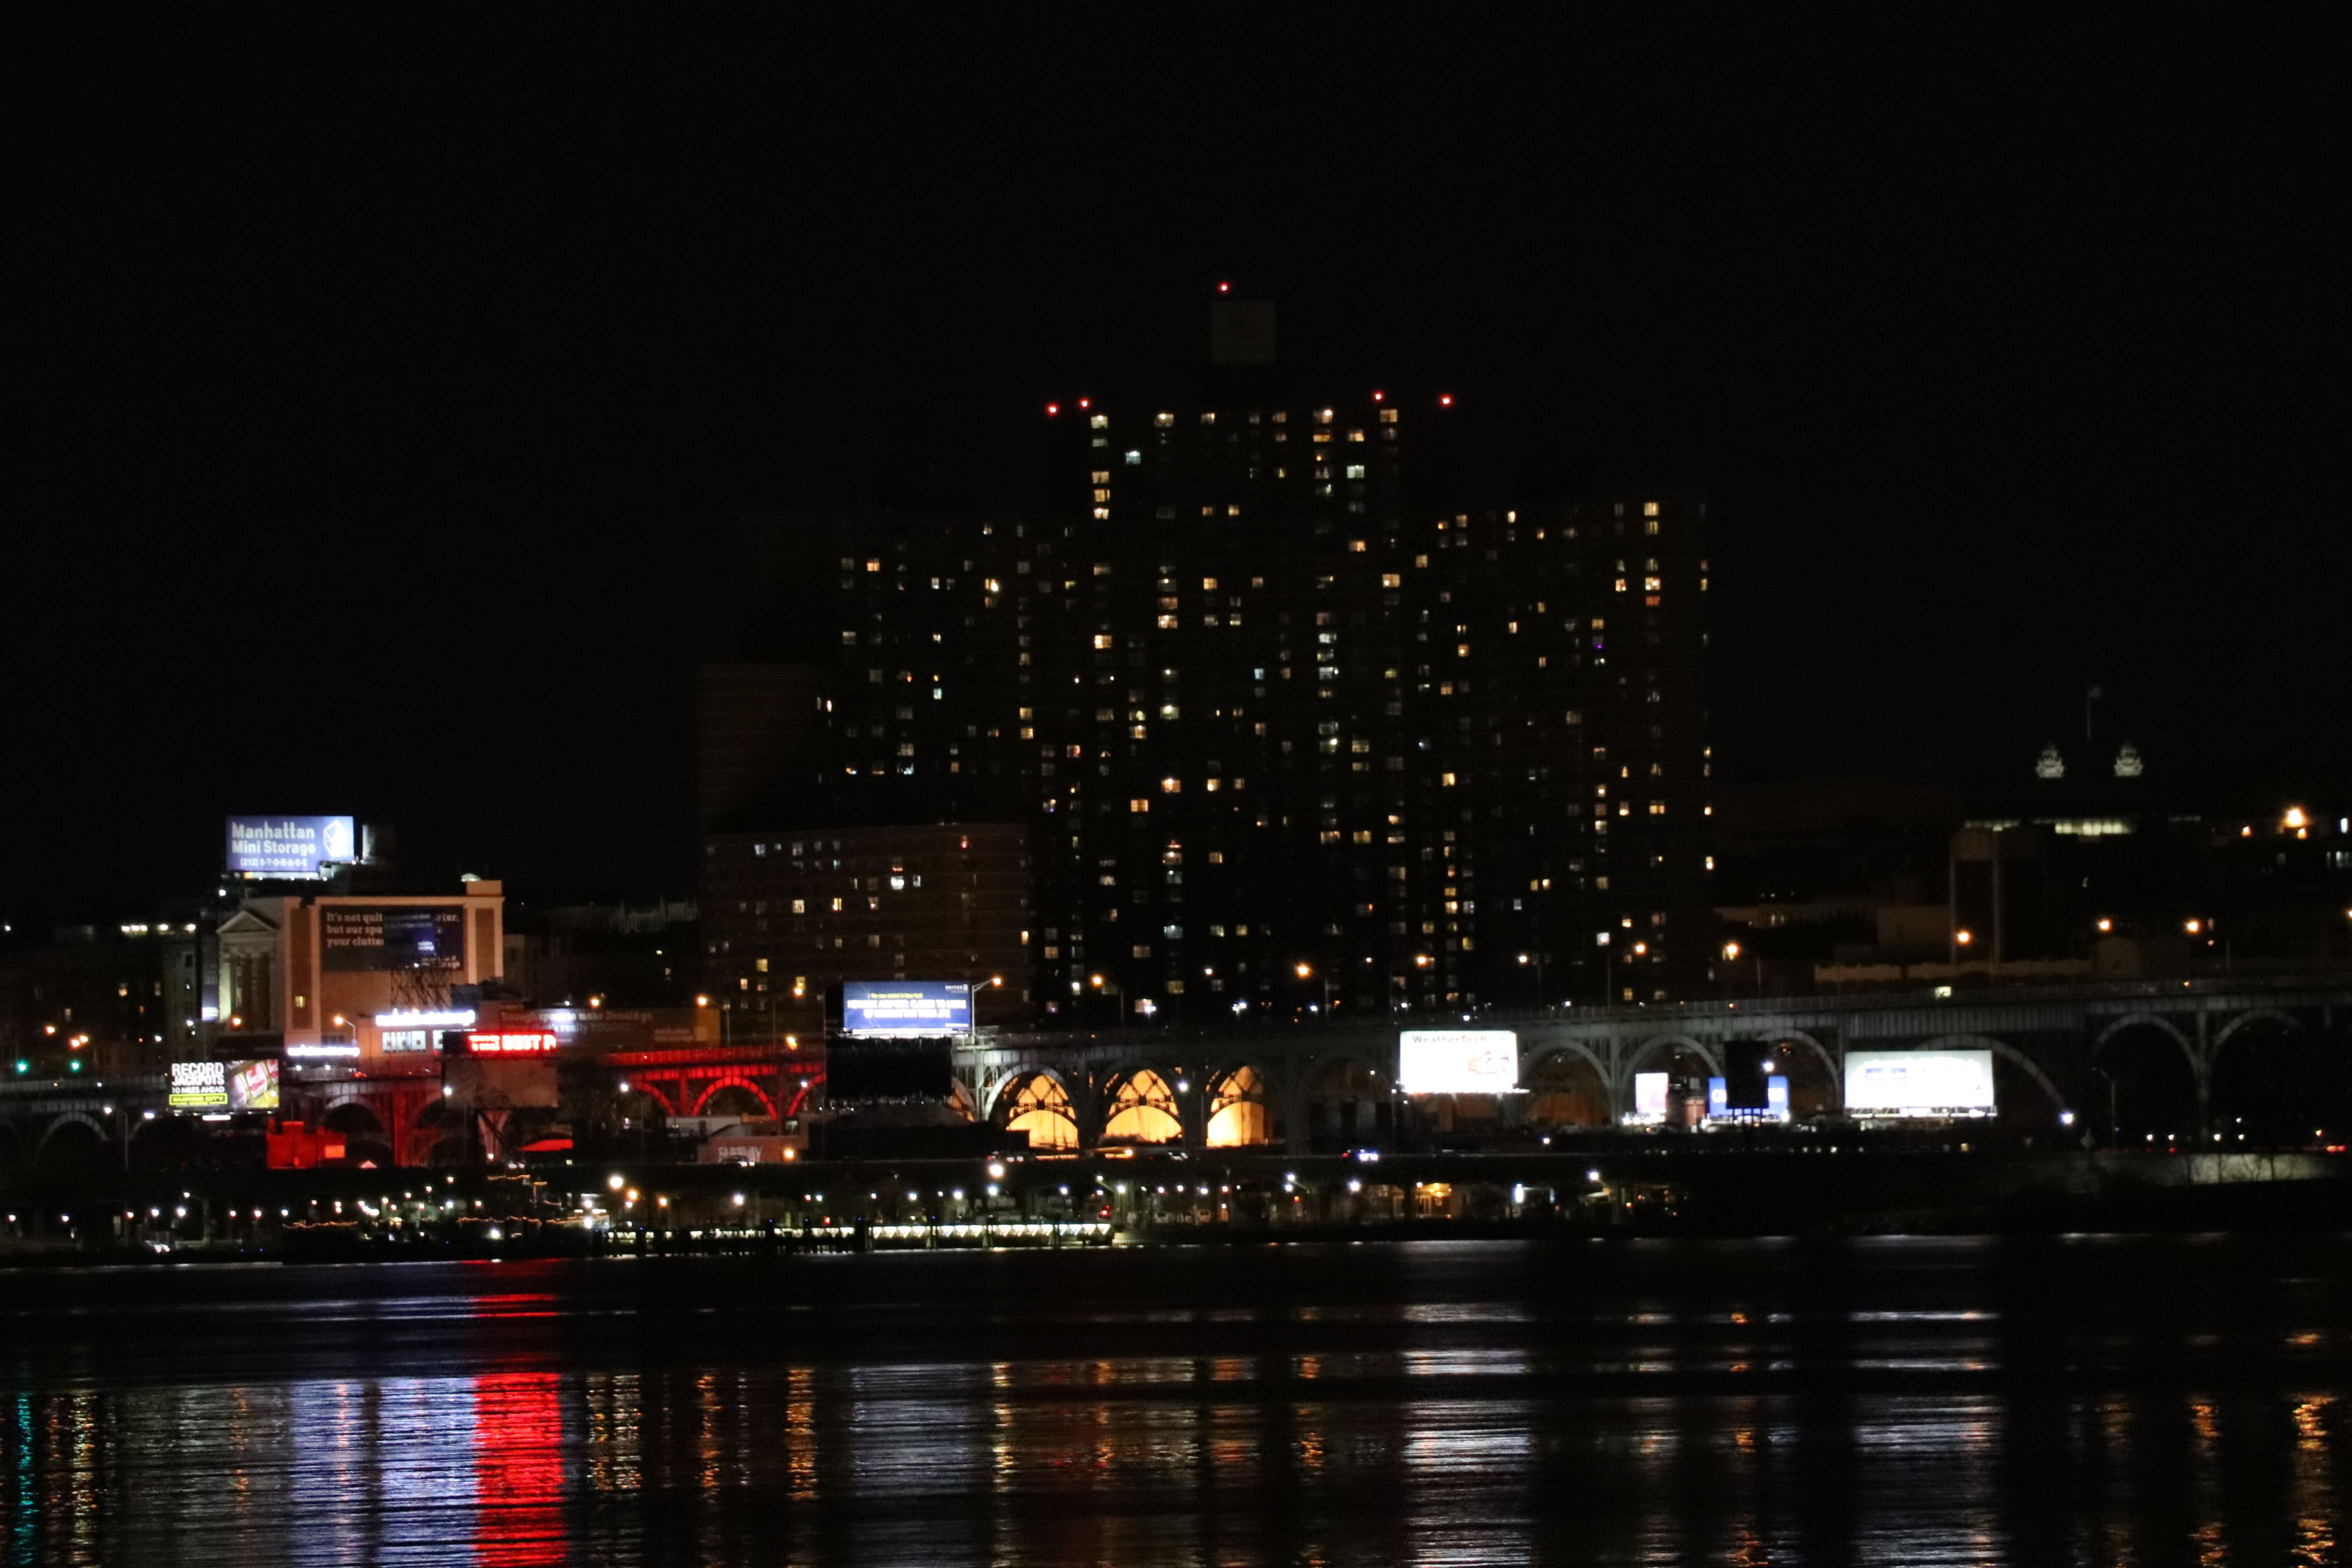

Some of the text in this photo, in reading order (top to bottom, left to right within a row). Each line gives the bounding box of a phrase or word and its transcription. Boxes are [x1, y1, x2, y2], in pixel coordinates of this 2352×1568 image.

[232, 821, 315, 839] Manhattan
[231, 840, 316, 856] Mini Storage
[326, 912, 342, 922] It's
[344, 913, 361, 922] not
[326, 924, 343, 934] but
[346, 926, 363, 934] our
[326, 938, 350, 948] your
[579, 1011, 603, 1020] make
[606, 1011, 639, 1020] Donald
[171, 1062, 224, 1076] RECORD
[172, 1075, 225, 1085] JACKPOTS
